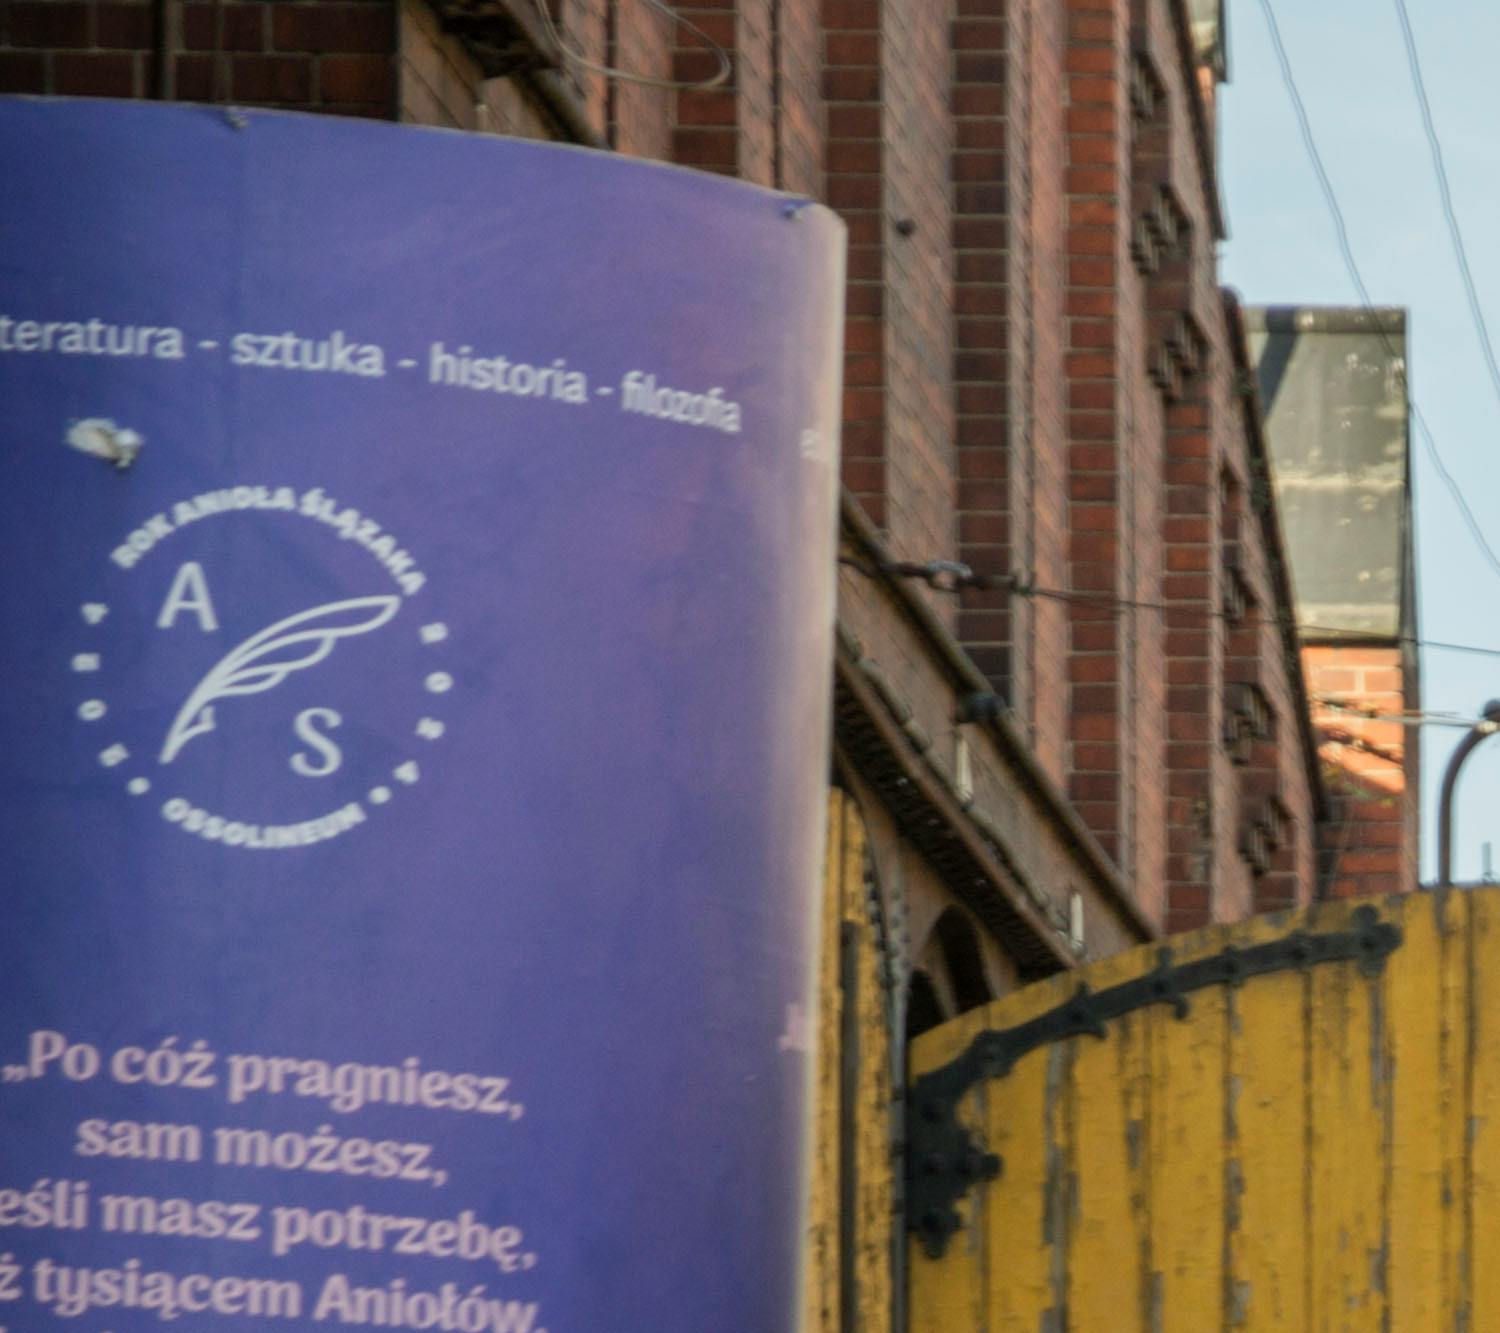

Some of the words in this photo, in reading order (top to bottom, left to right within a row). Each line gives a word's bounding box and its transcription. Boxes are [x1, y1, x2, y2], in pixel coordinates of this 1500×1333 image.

[231, 329, 385, 378] sztuka
[429, 341, 587, 404] historia
[621, 371, 742, 433] filozofia
[156, 561, 220, 632] A
[289, 706, 343, 777] S
[112, 1037, 214, 1088] cóż
[228, 1052, 524, 1121] pragniesz,
[76, 1117, 200, 1162] sam
[214, 1123, 448, 1187] możesz,
[101, 1193, 262, 1241] masz
[273, 1204, 537, 1272] potrzebę,
[34, 1258, 302, 1320] tysiącem
